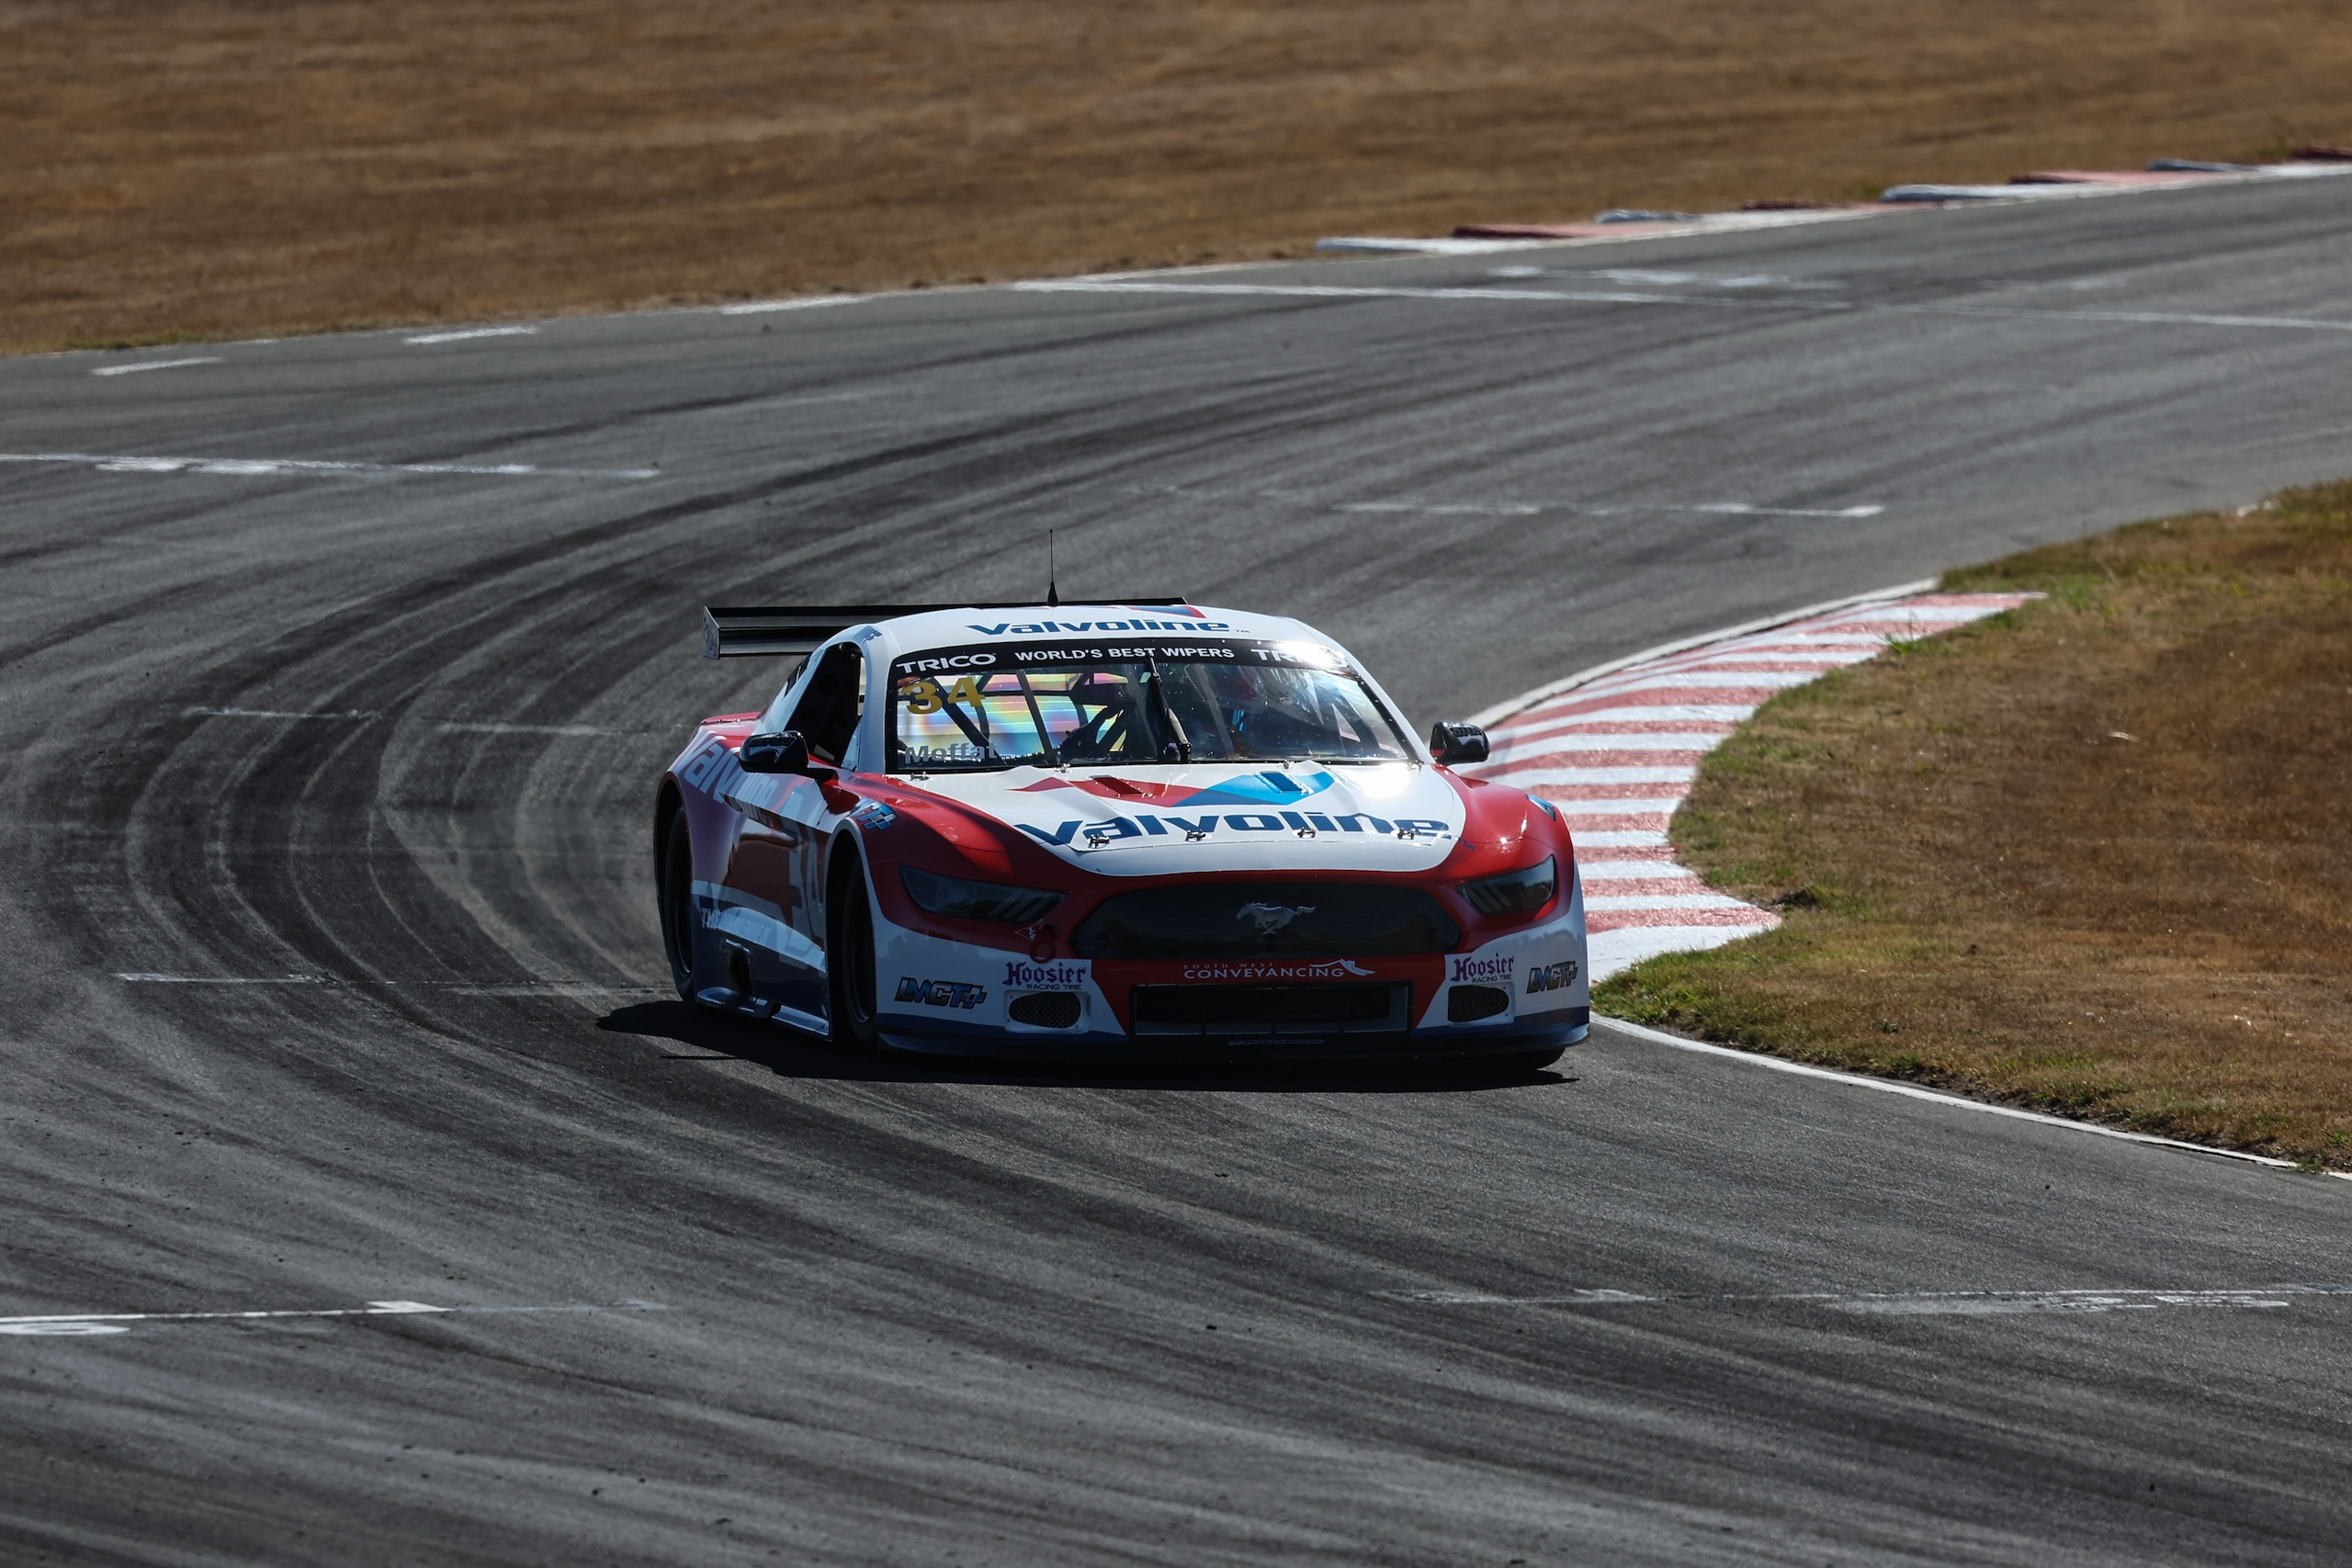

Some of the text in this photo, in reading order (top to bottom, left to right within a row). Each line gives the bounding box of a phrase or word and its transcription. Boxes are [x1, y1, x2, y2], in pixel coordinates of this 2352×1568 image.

[967, 619, 1230, 636] Valvoline
[896, 653, 997, 673] TRICO
[1014, 648, 1235, 661] WORLD'S BEST WIPERS
[901, 677, 985, 715] 34
[903, 742, 998, 764] Moffat
[1012, 810, 1453, 846] Valvoline
[1001, 961, 1087, 986] Hoosier
[1183, 967, 1345, 979] CONVEYANCING
[1450, 953, 1514, 982] Hoosier
